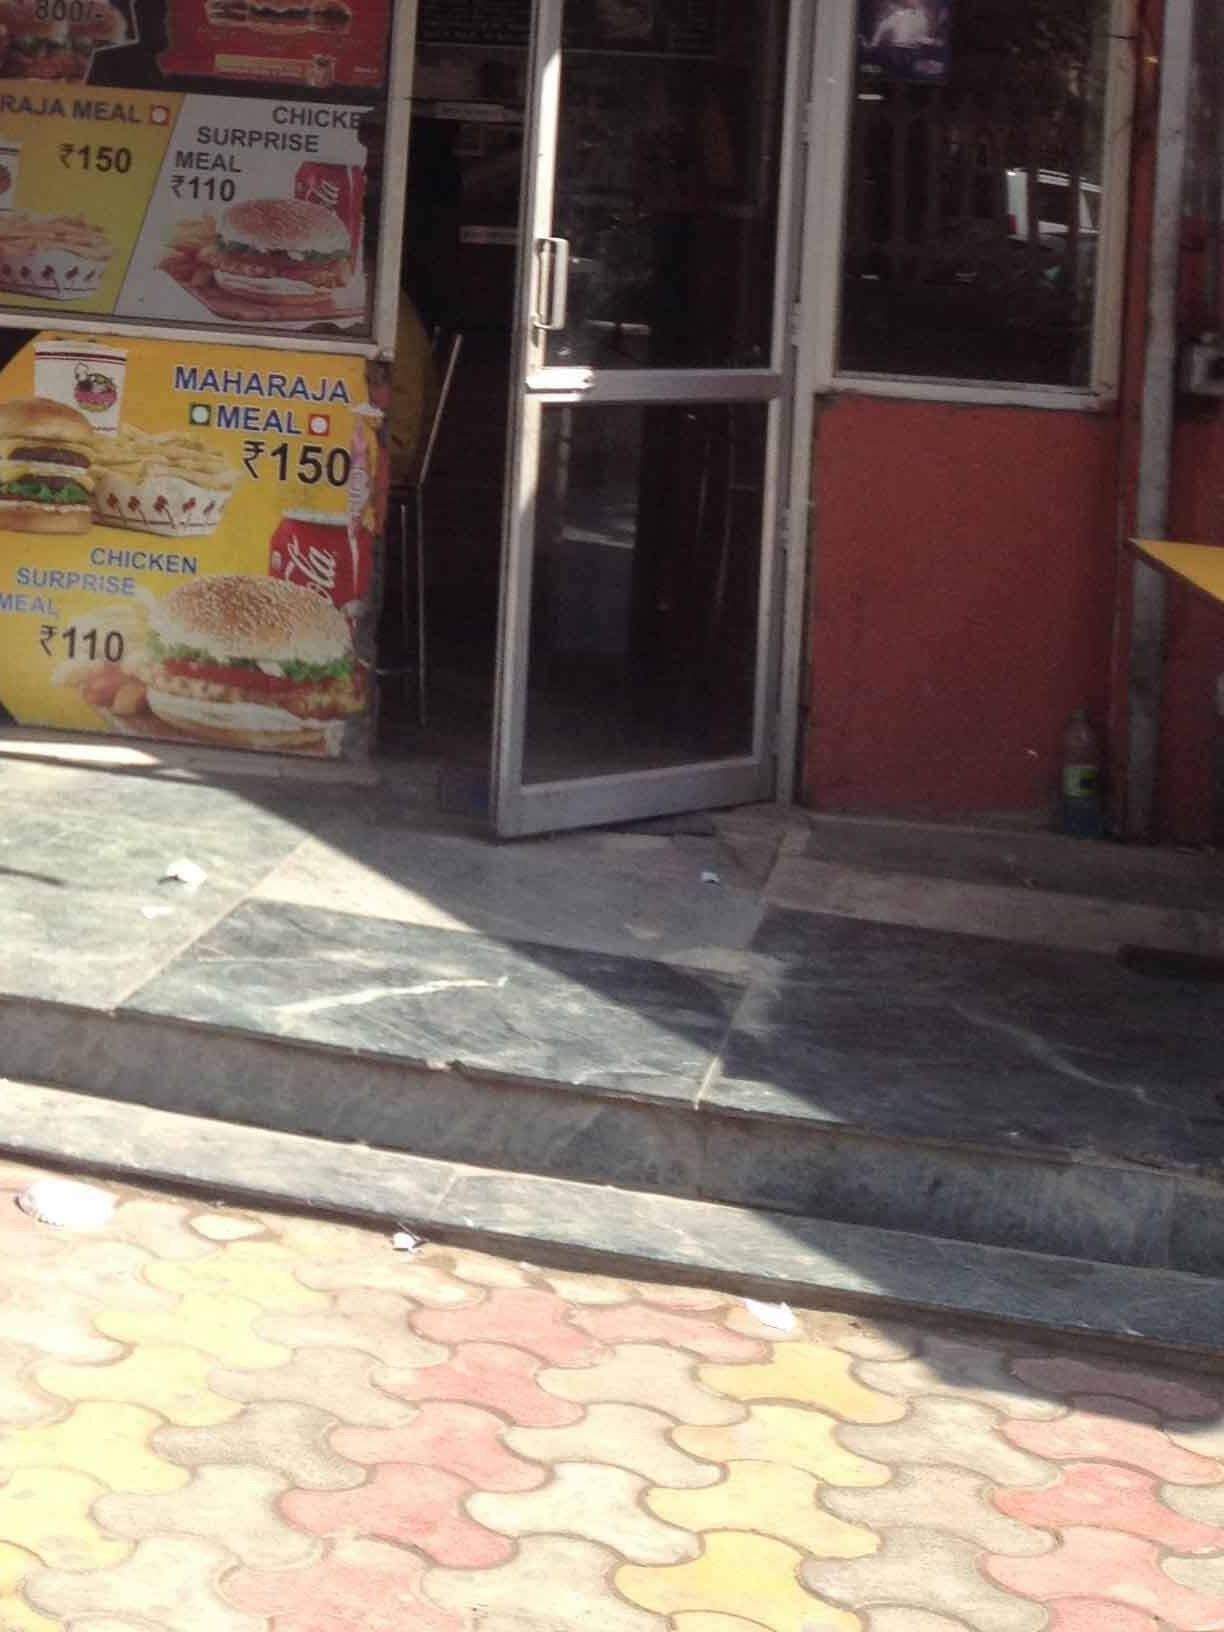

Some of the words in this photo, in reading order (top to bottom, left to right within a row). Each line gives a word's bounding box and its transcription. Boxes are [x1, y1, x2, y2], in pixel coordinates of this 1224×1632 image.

[72, 99, 143, 126] MEAL
[196, 125, 321, 154] SURPRISE
[175, 151, 242, 174] MEAL
[173, 364, 351, 405] MAHARAJA
[215, 404, 302, 437] MEAL
[89, 546, 199, 576] CHICKEN
[15, 566, 137, 597] SURPRISE
